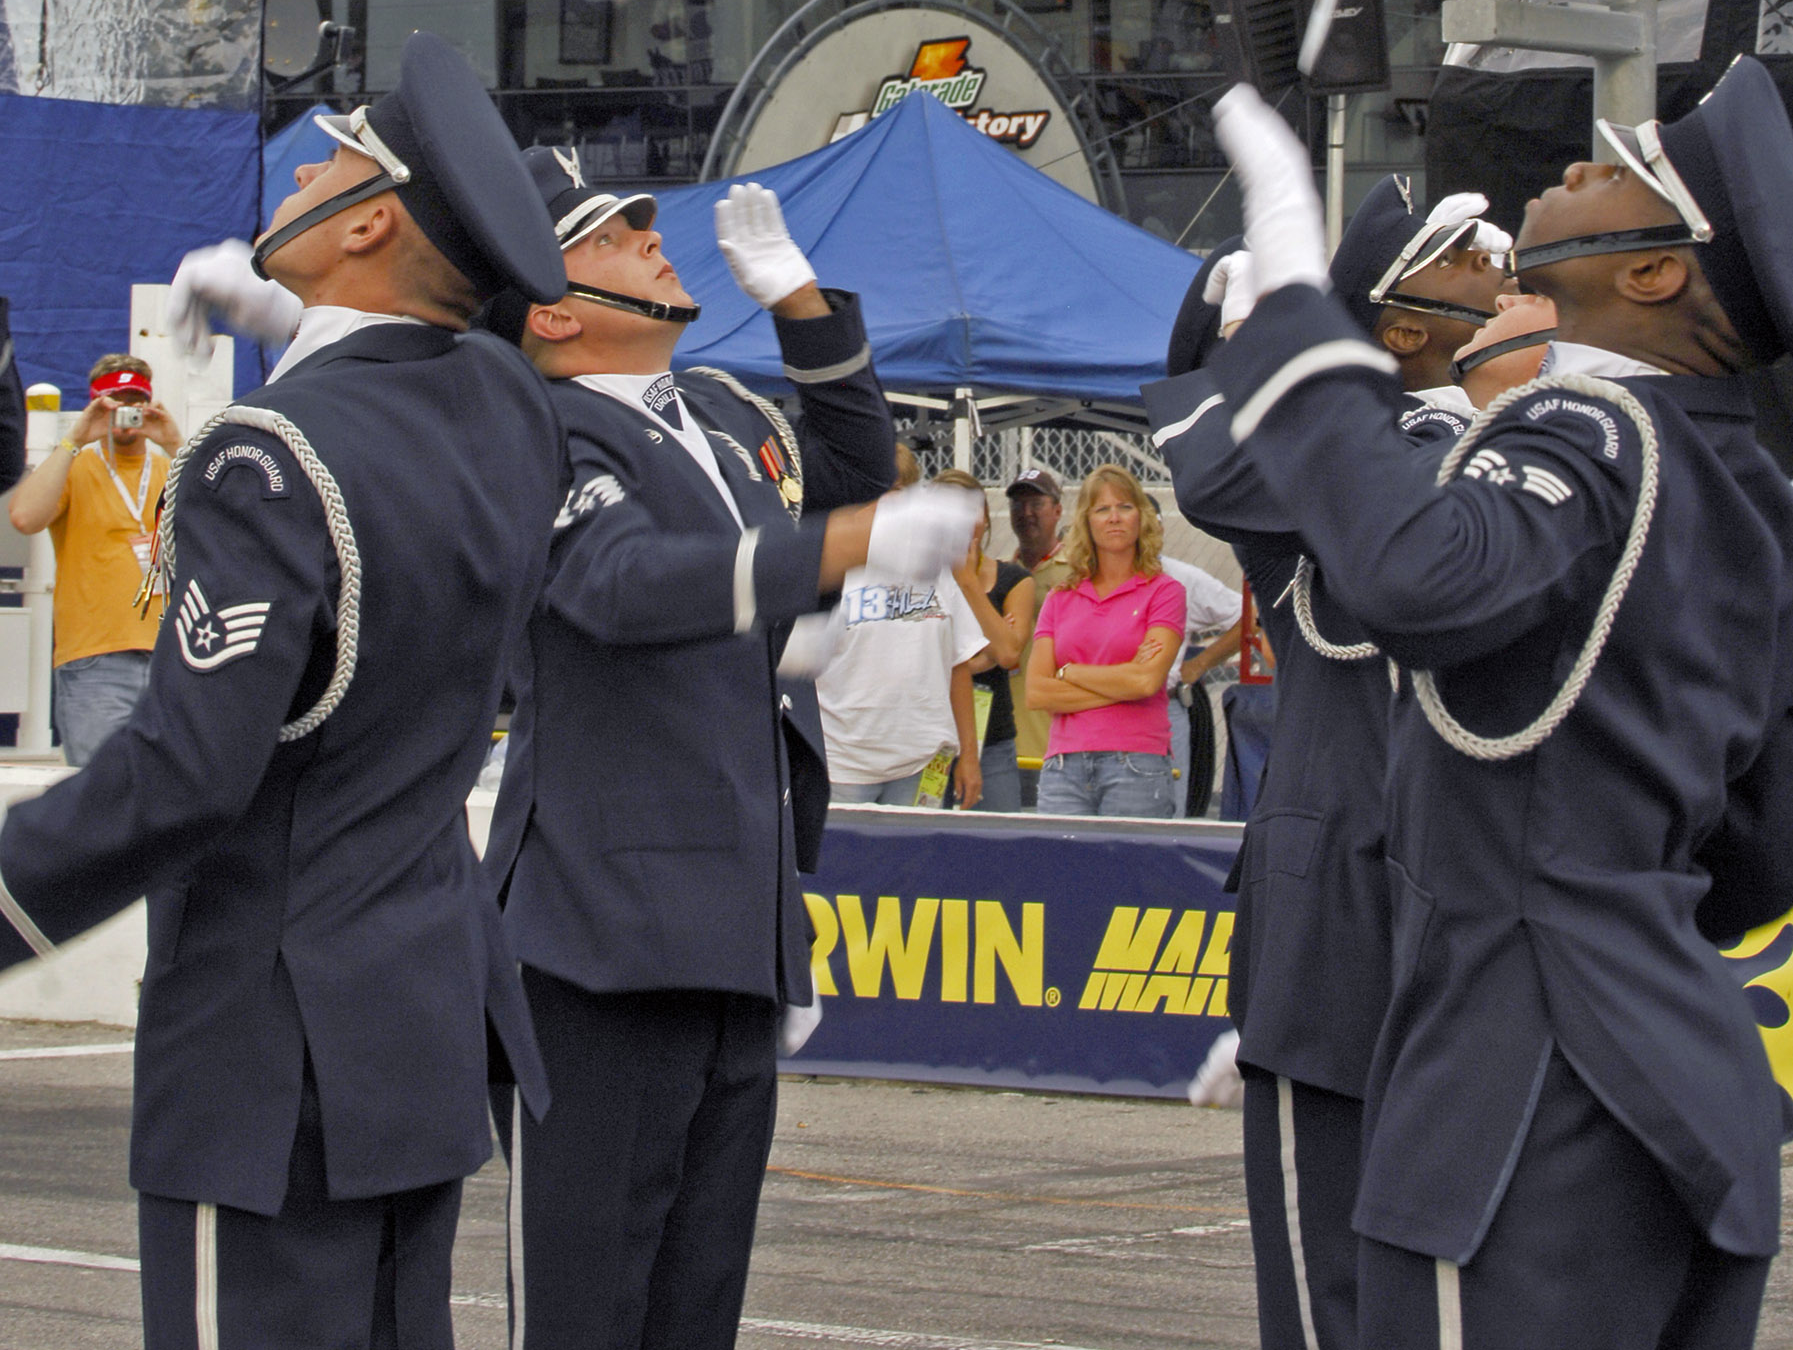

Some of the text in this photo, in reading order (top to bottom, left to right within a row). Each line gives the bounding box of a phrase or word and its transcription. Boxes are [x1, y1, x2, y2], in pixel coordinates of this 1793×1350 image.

[1401, 413, 1429, 430] USAF
[1429, 412, 1461, 426] HONOR
[1526, 398, 1619, 459] USAF HONOR GUARD
[205, 445, 284, 492] USAF HONOR GUARD
[846, 586, 888, 625] 13
